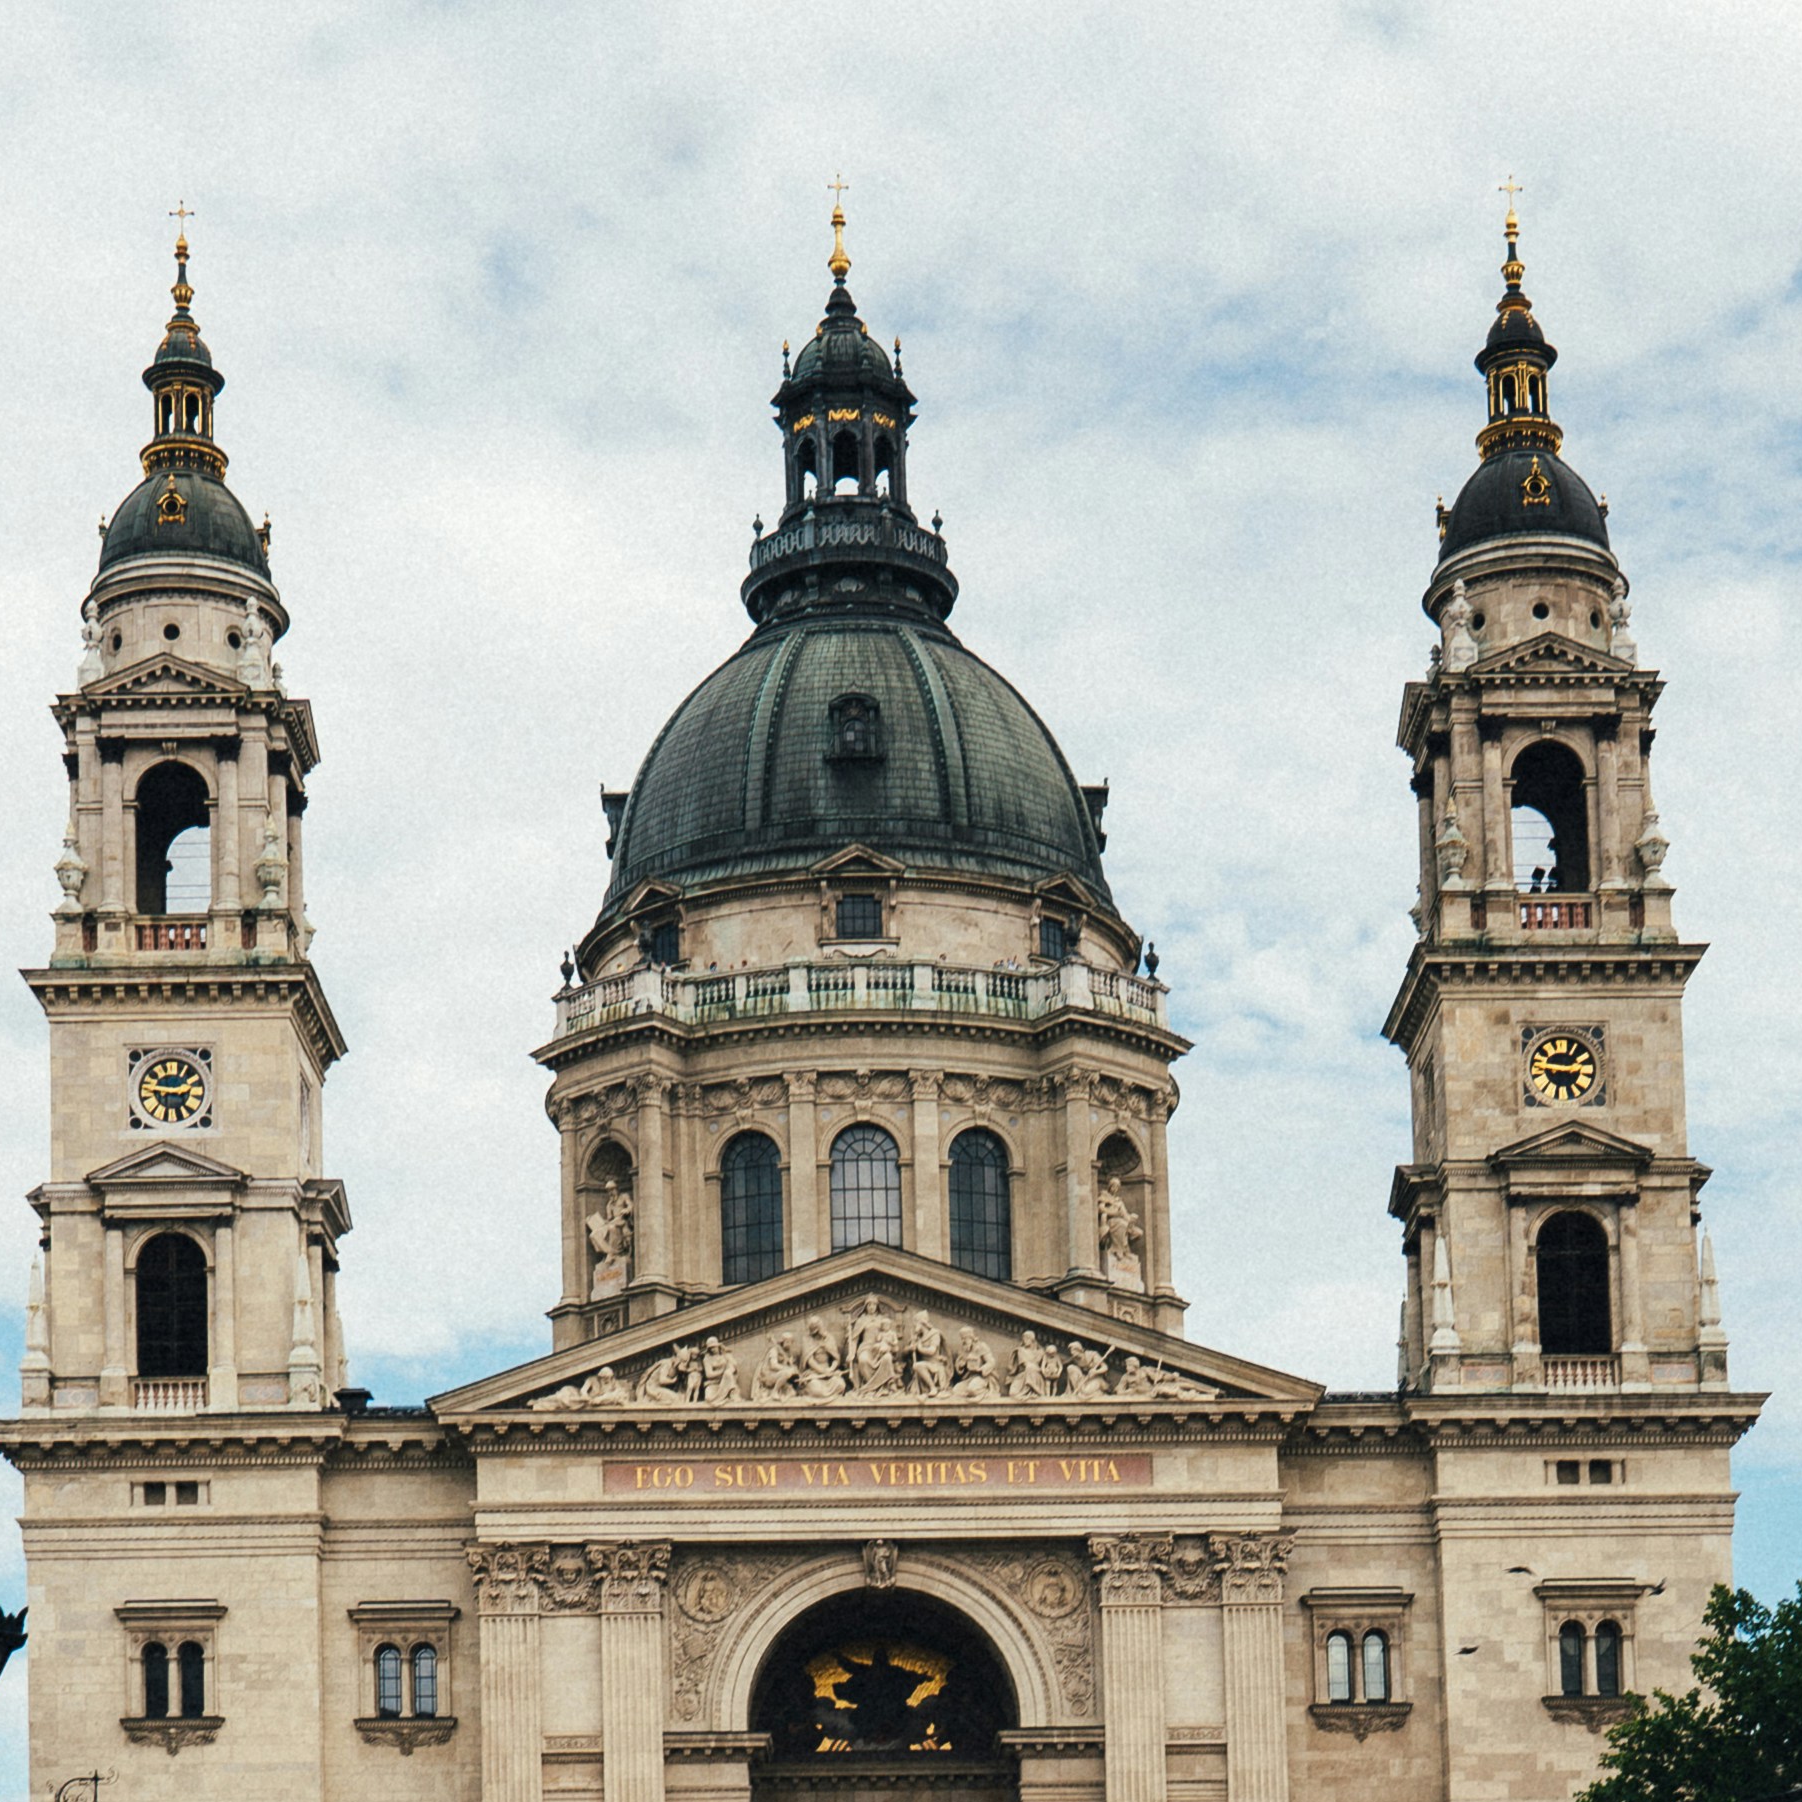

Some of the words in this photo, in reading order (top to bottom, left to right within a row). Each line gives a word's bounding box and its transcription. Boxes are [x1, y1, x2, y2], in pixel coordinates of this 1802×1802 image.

[635, 1466, 694, 1488] EGO
[714, 1464, 778, 1487] SUM
[801, 1463, 850, 1486] VIA
[870, 1461, 987, 1486] VERITAS
[1007, 1461, 1040, 1483] ET
[1058, 1458, 1122, 1481] VITA
